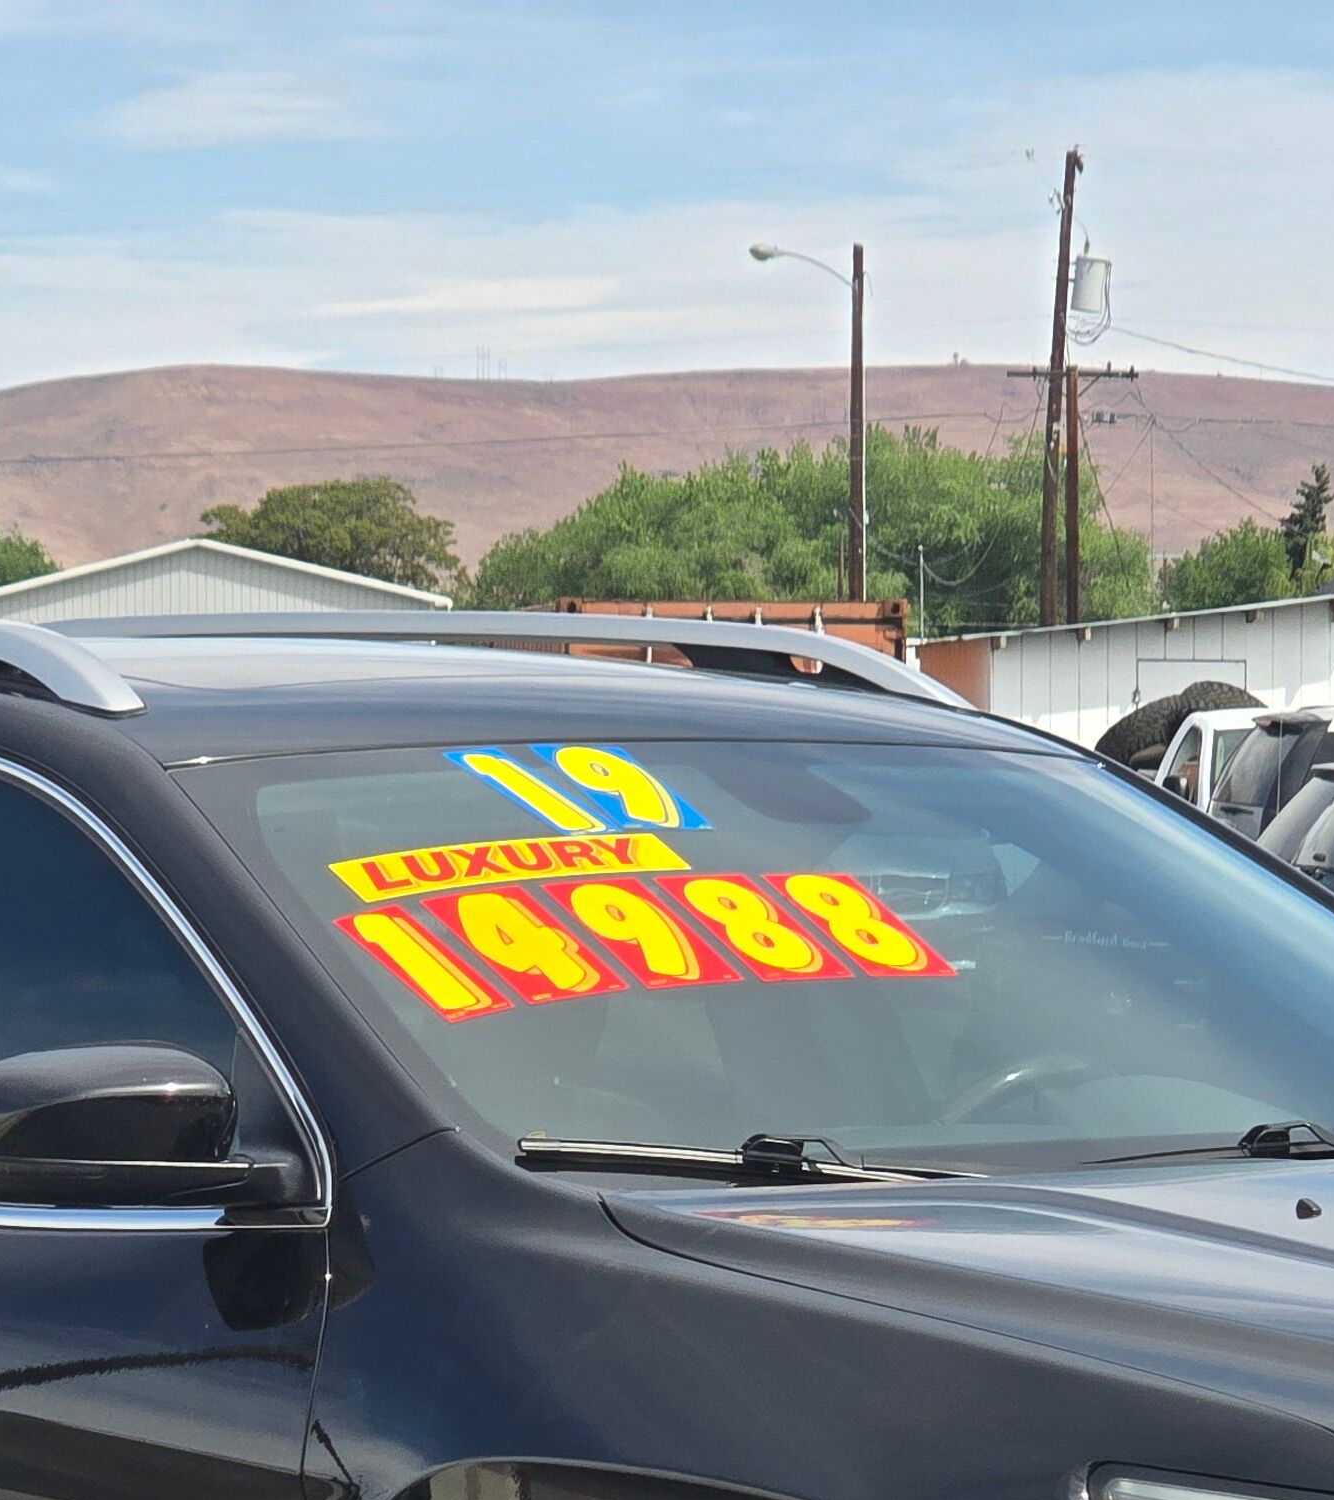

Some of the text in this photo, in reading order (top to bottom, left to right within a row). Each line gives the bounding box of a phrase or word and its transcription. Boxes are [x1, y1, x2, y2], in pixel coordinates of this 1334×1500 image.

[462, 746, 681, 833] 19
[363, 836, 645, 893] LUXURY
[352, 873, 929, 1011] 14988
